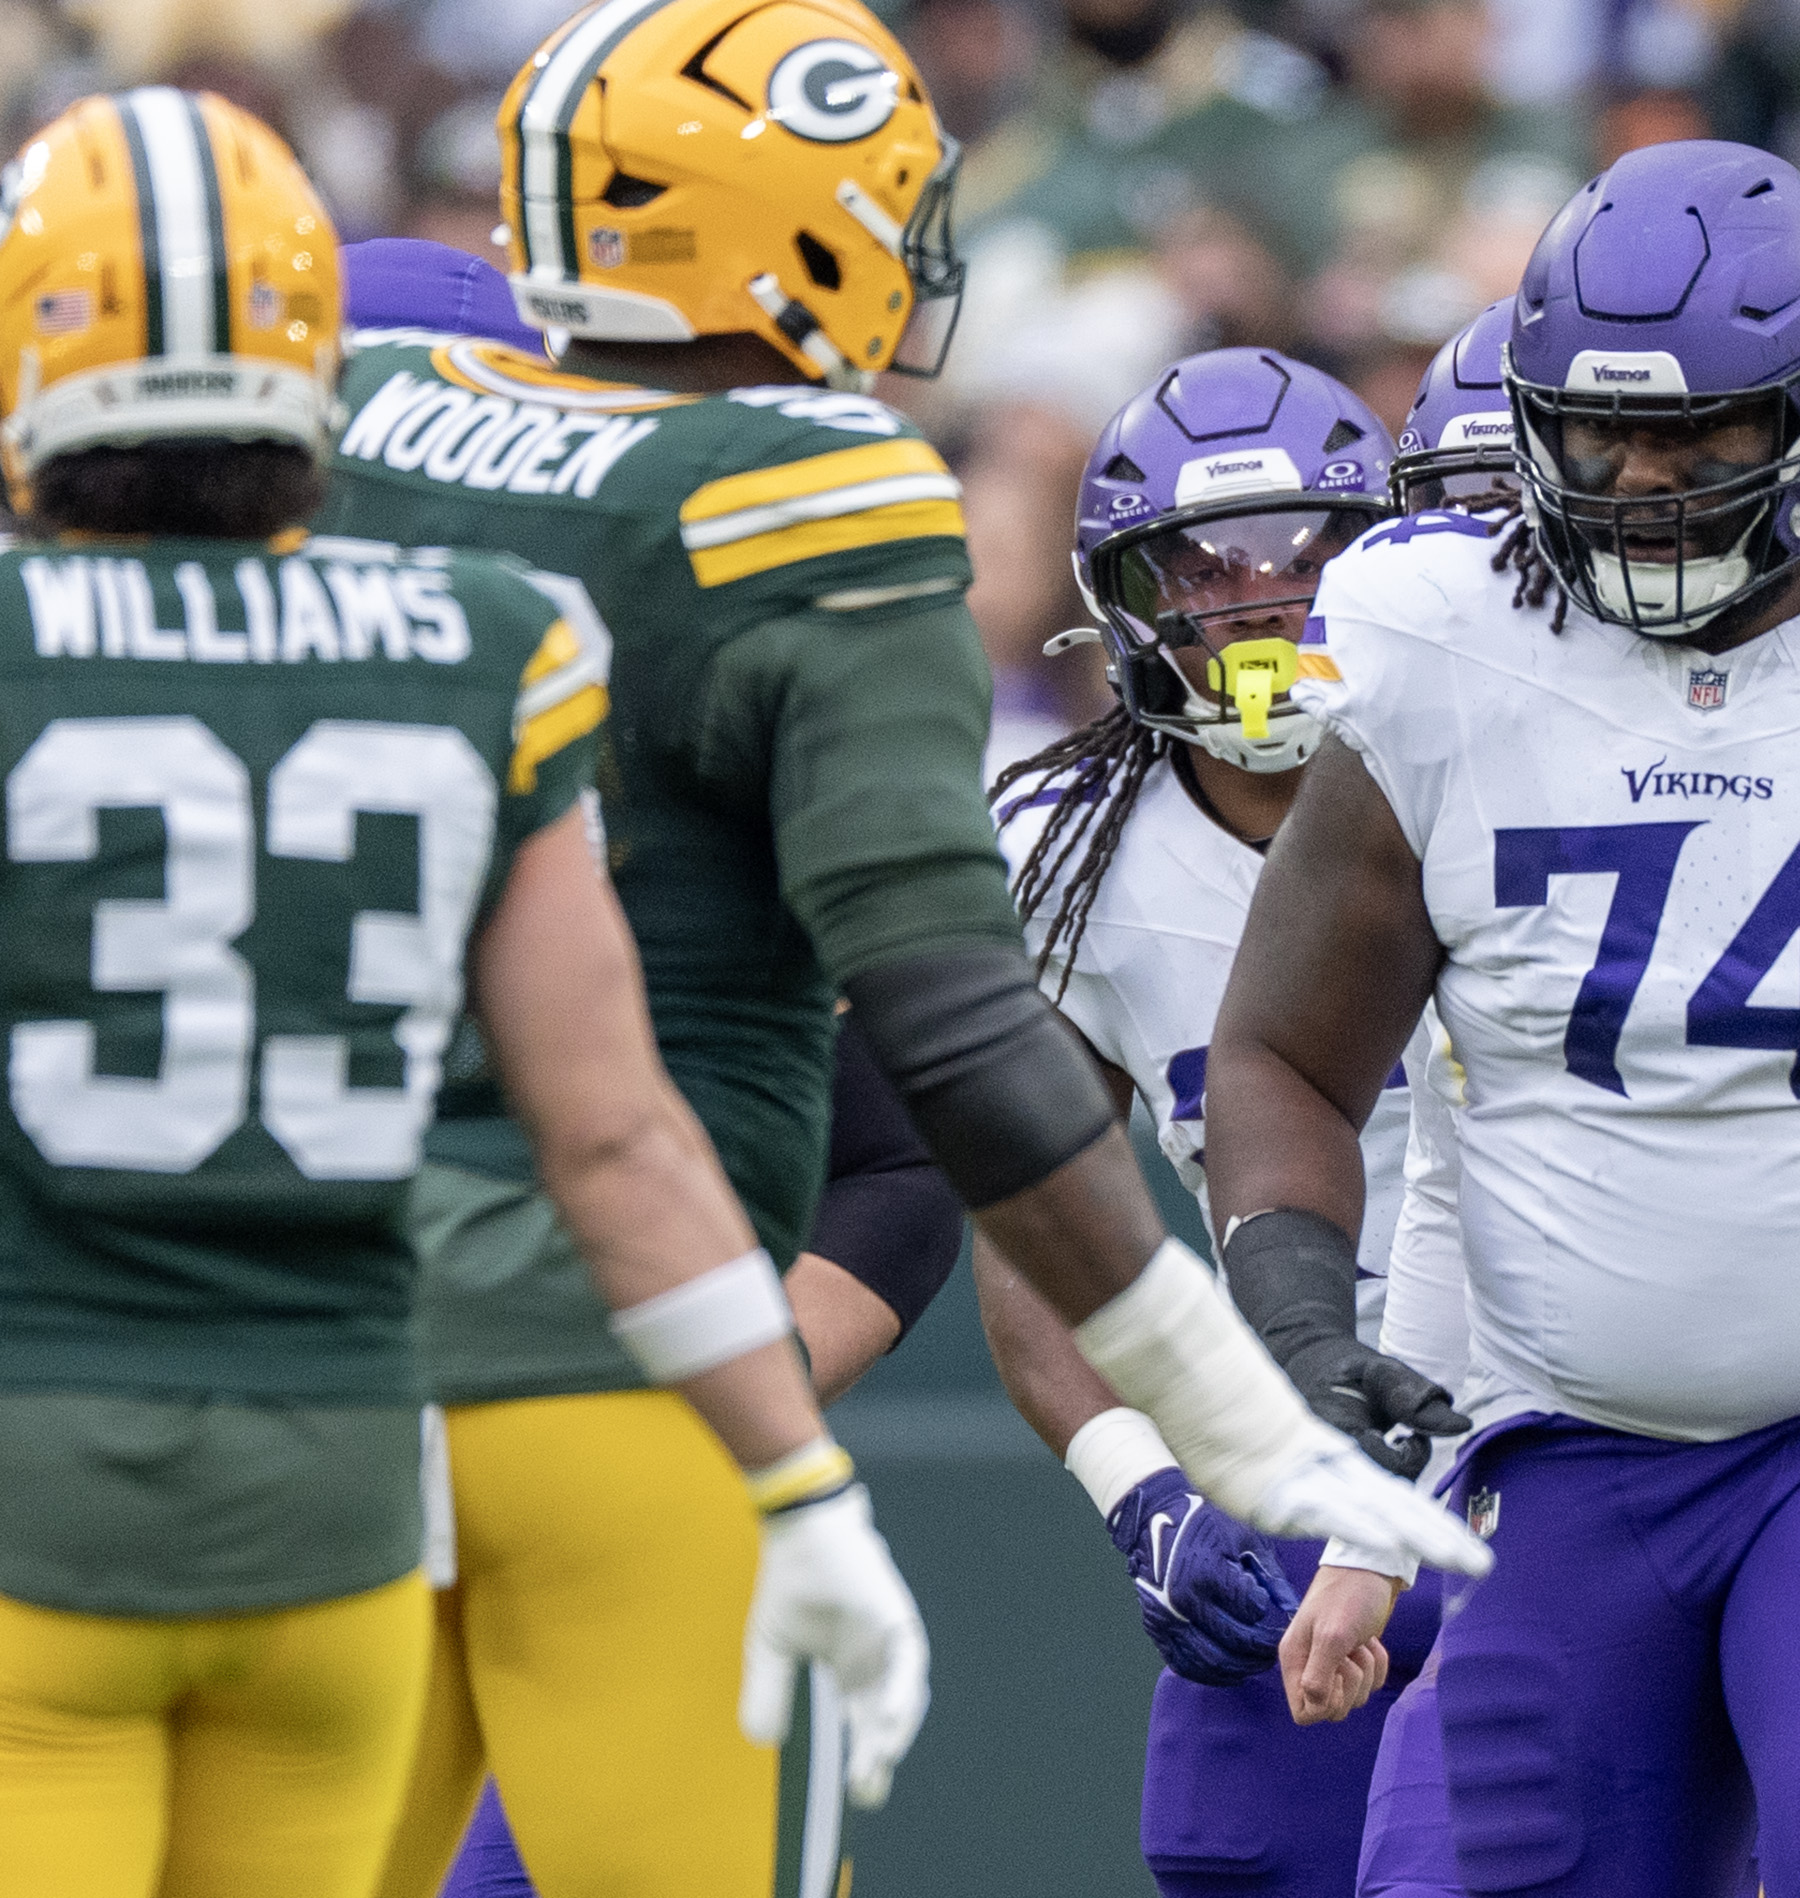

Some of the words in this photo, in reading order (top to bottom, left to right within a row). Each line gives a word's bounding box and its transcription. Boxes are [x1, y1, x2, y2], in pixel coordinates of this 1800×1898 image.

[769, 39, 898, 141] G
[339, 372, 659, 498] WOODEN
[1319, 475, 1363, 488] OAKLEY
[20, 559, 472, 664] WILLIAMS
[1692, 686, 1721, 705] NFL
[4, 715, 498, 1180] 33
